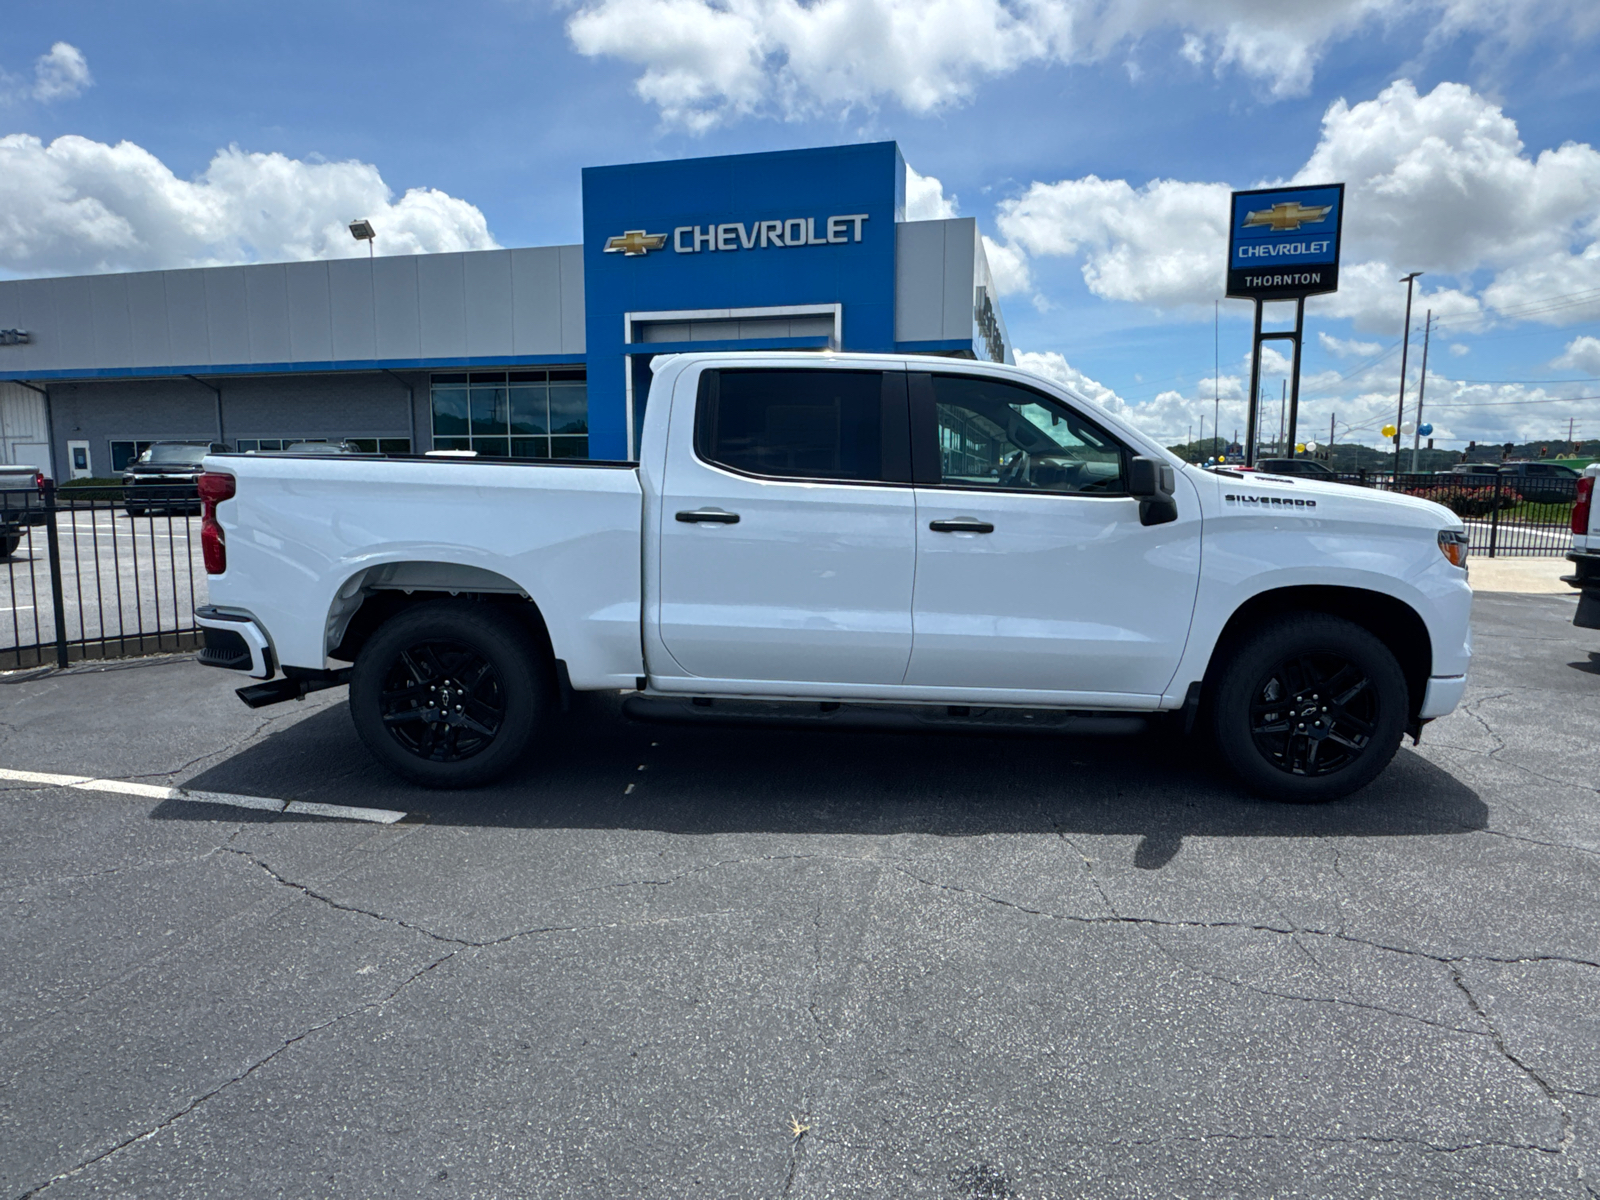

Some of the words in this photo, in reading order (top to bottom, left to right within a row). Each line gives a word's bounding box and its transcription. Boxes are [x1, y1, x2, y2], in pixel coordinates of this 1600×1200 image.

[674, 214, 869, 253] CHEVROLET
[1238, 241, 1330, 258] CHEVROLET
[1245, 273, 1321, 287] THORNTON
[1225, 494, 1317, 507] SILVERADO
